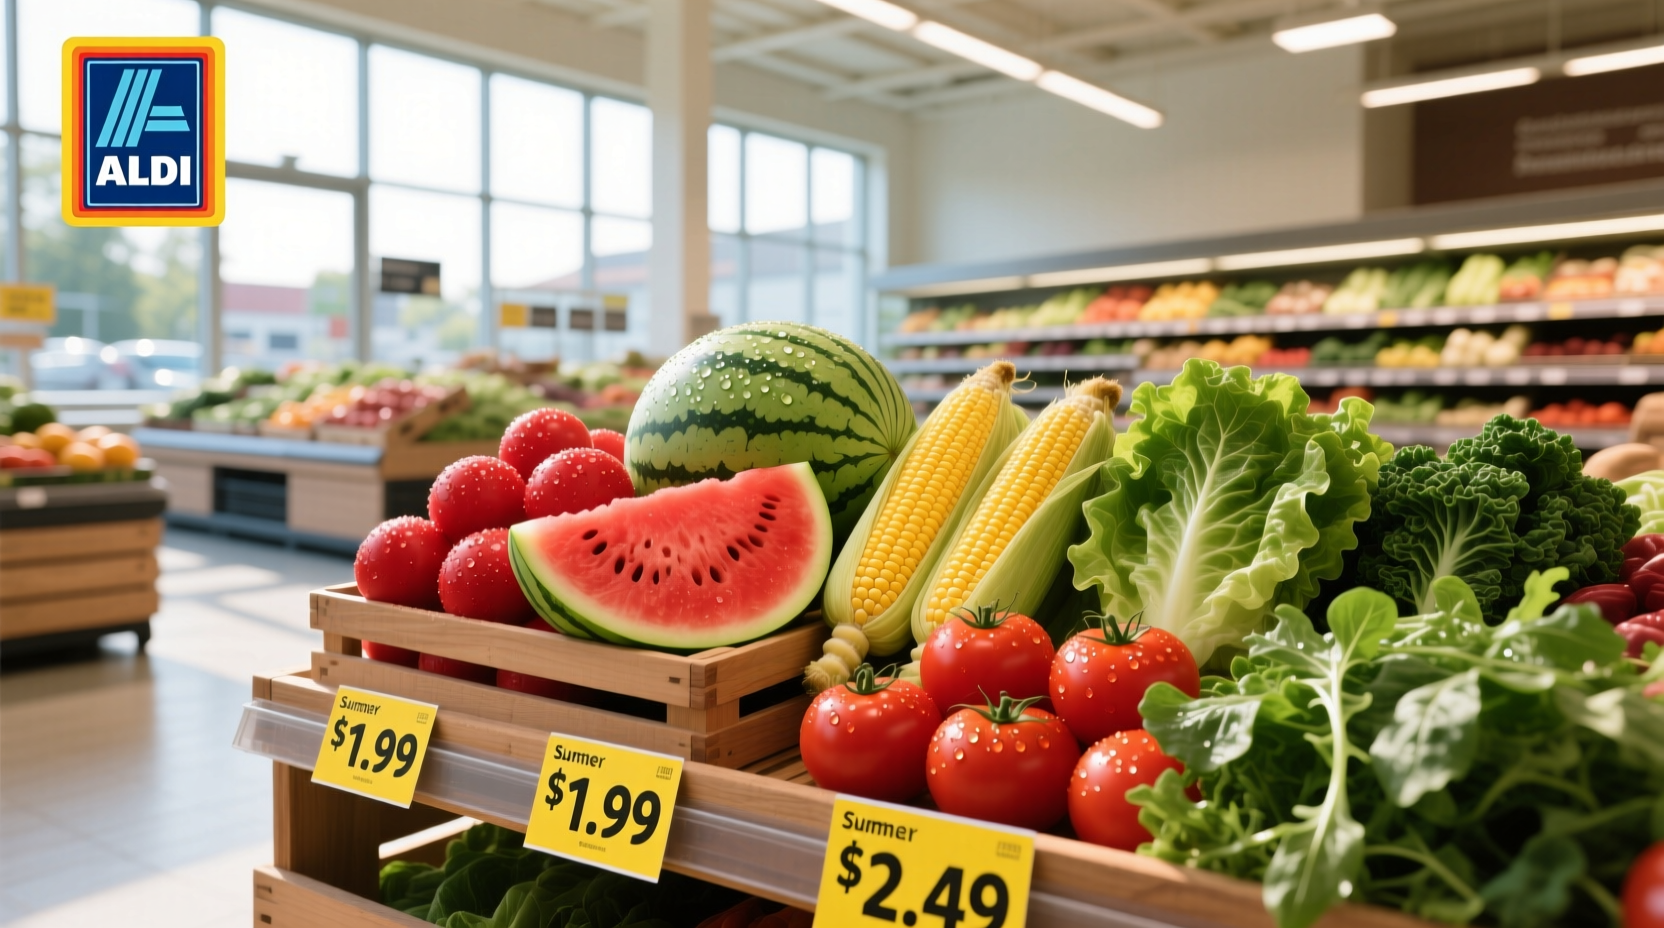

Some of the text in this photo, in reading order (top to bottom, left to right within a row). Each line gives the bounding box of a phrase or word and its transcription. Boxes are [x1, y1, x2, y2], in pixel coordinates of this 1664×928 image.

[331, 715, 418, 778] $1.99
[544, 767, 661, 846] $1.99
[837, 840, 1010, 928] $2.49
